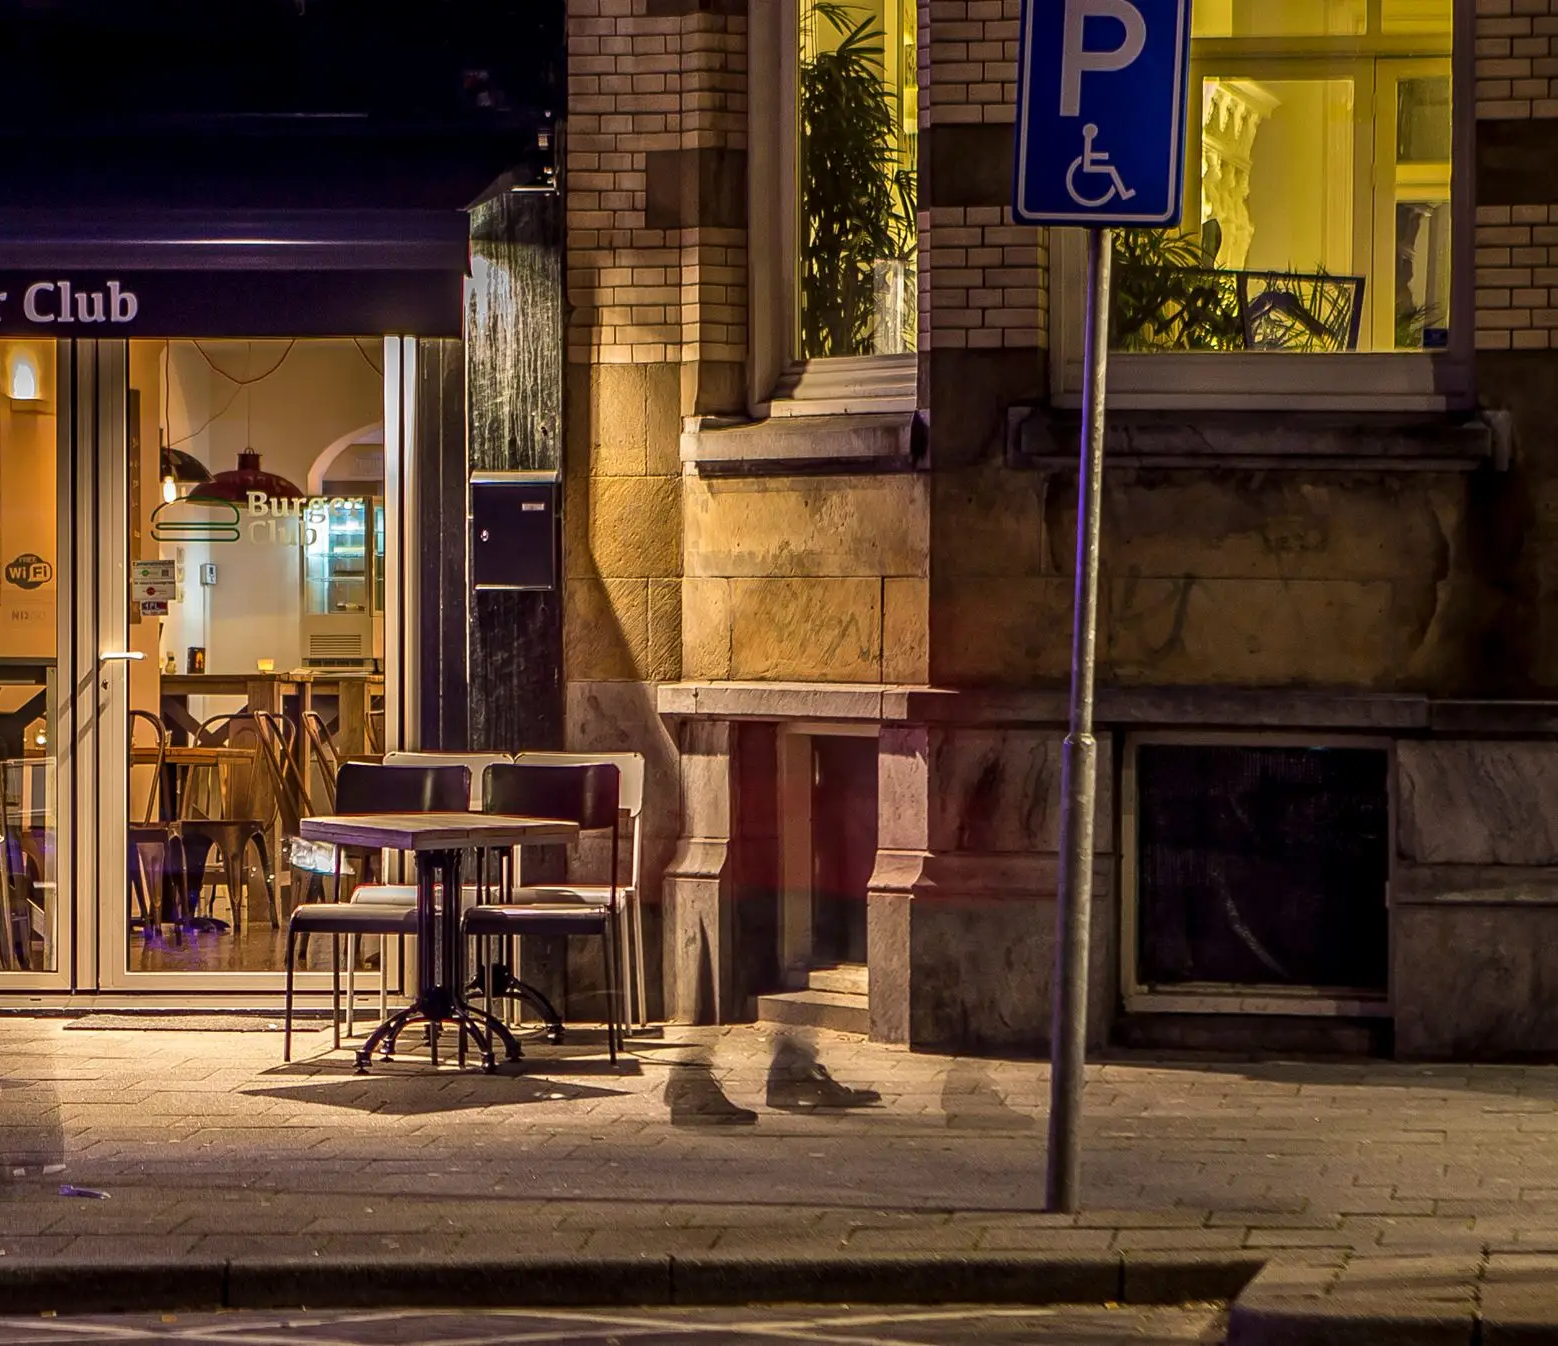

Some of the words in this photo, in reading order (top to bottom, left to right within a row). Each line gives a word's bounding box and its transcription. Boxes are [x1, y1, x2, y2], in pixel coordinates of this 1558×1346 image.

[1059, 0, 1147, 117] P
[23, 281, 139, 324] Club
[246, 490, 363, 524] Burger
[248, 519, 317, 547] Club
